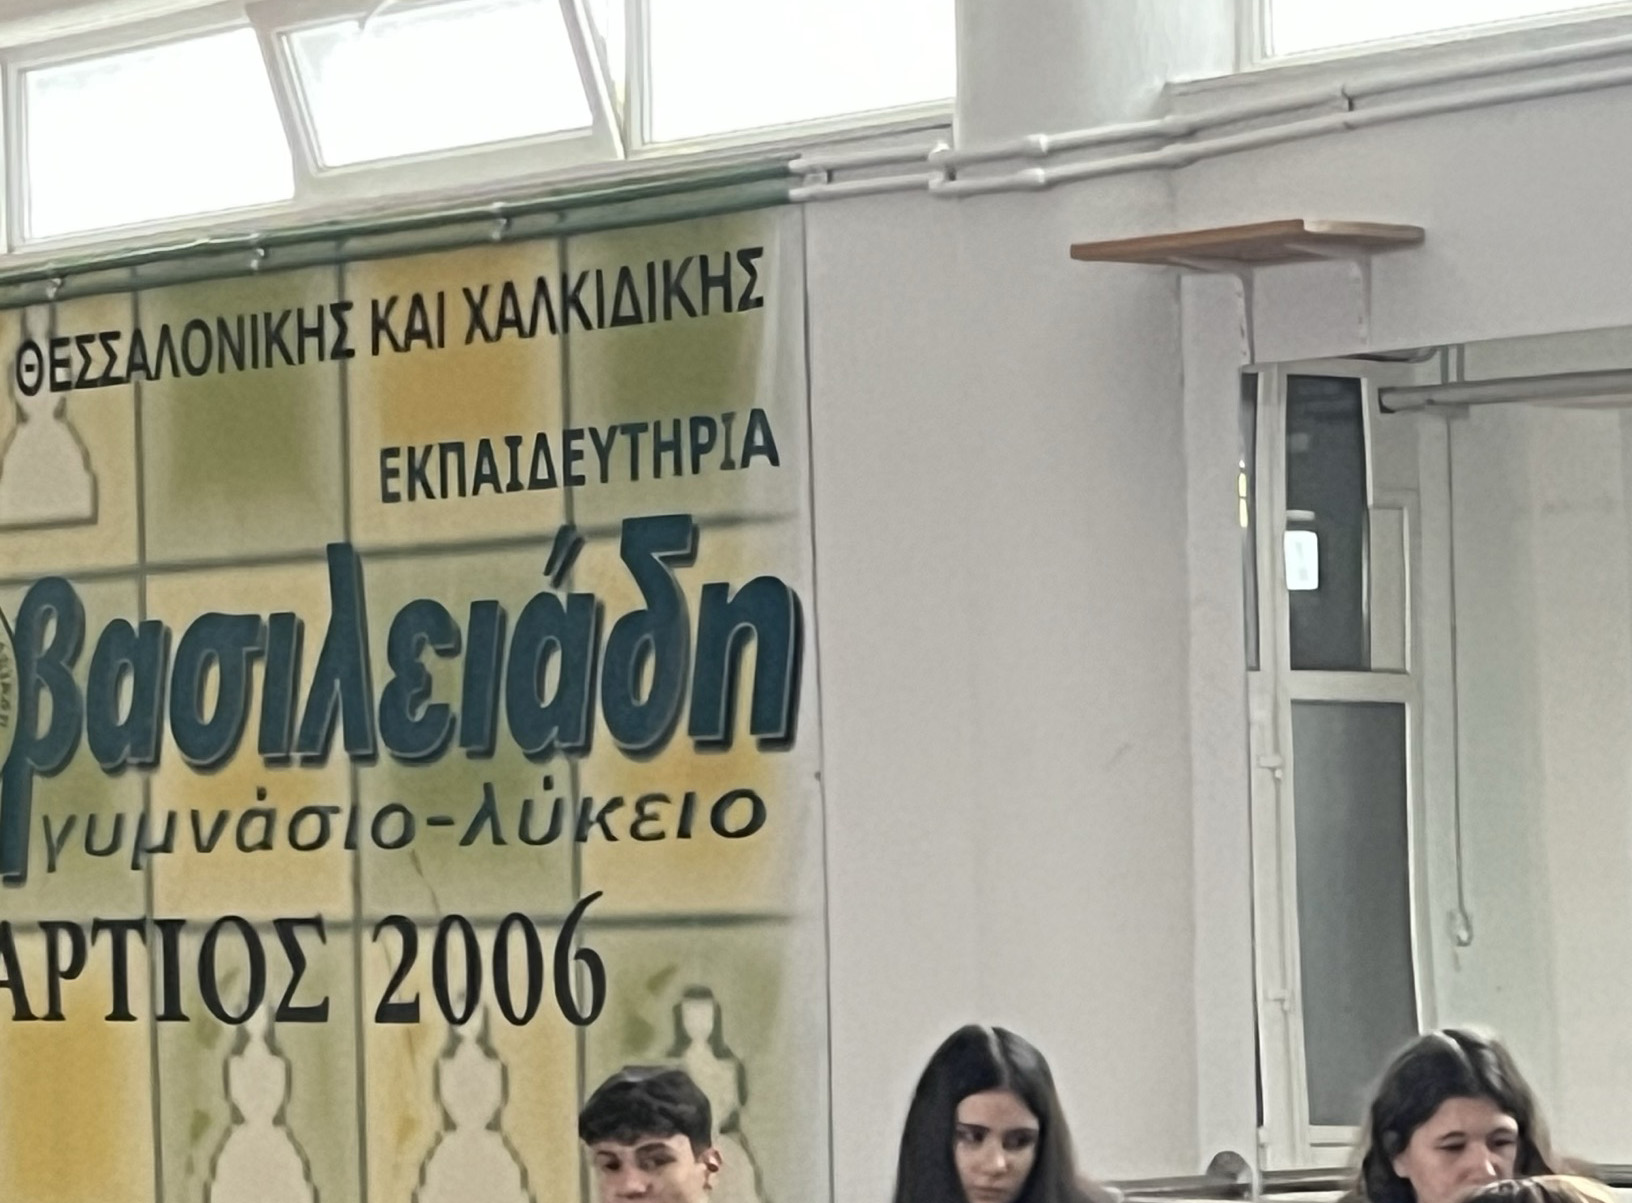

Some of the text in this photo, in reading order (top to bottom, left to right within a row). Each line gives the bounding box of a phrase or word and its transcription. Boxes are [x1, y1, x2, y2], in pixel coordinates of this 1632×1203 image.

[15, 246, 767, 397] ΘΕΣΣΑΛΟΝΙΚΗΣ ΚΑΙ ΧΑΛΚΙΔΙΚΗΣ
[379, 408, 780, 504] ΕΚΠΑΙΔΕΥΤΗΡΙΑ
[0, 513, 804, 886] βασιλειάδη
[371, 889, 607, 1028] 2006
